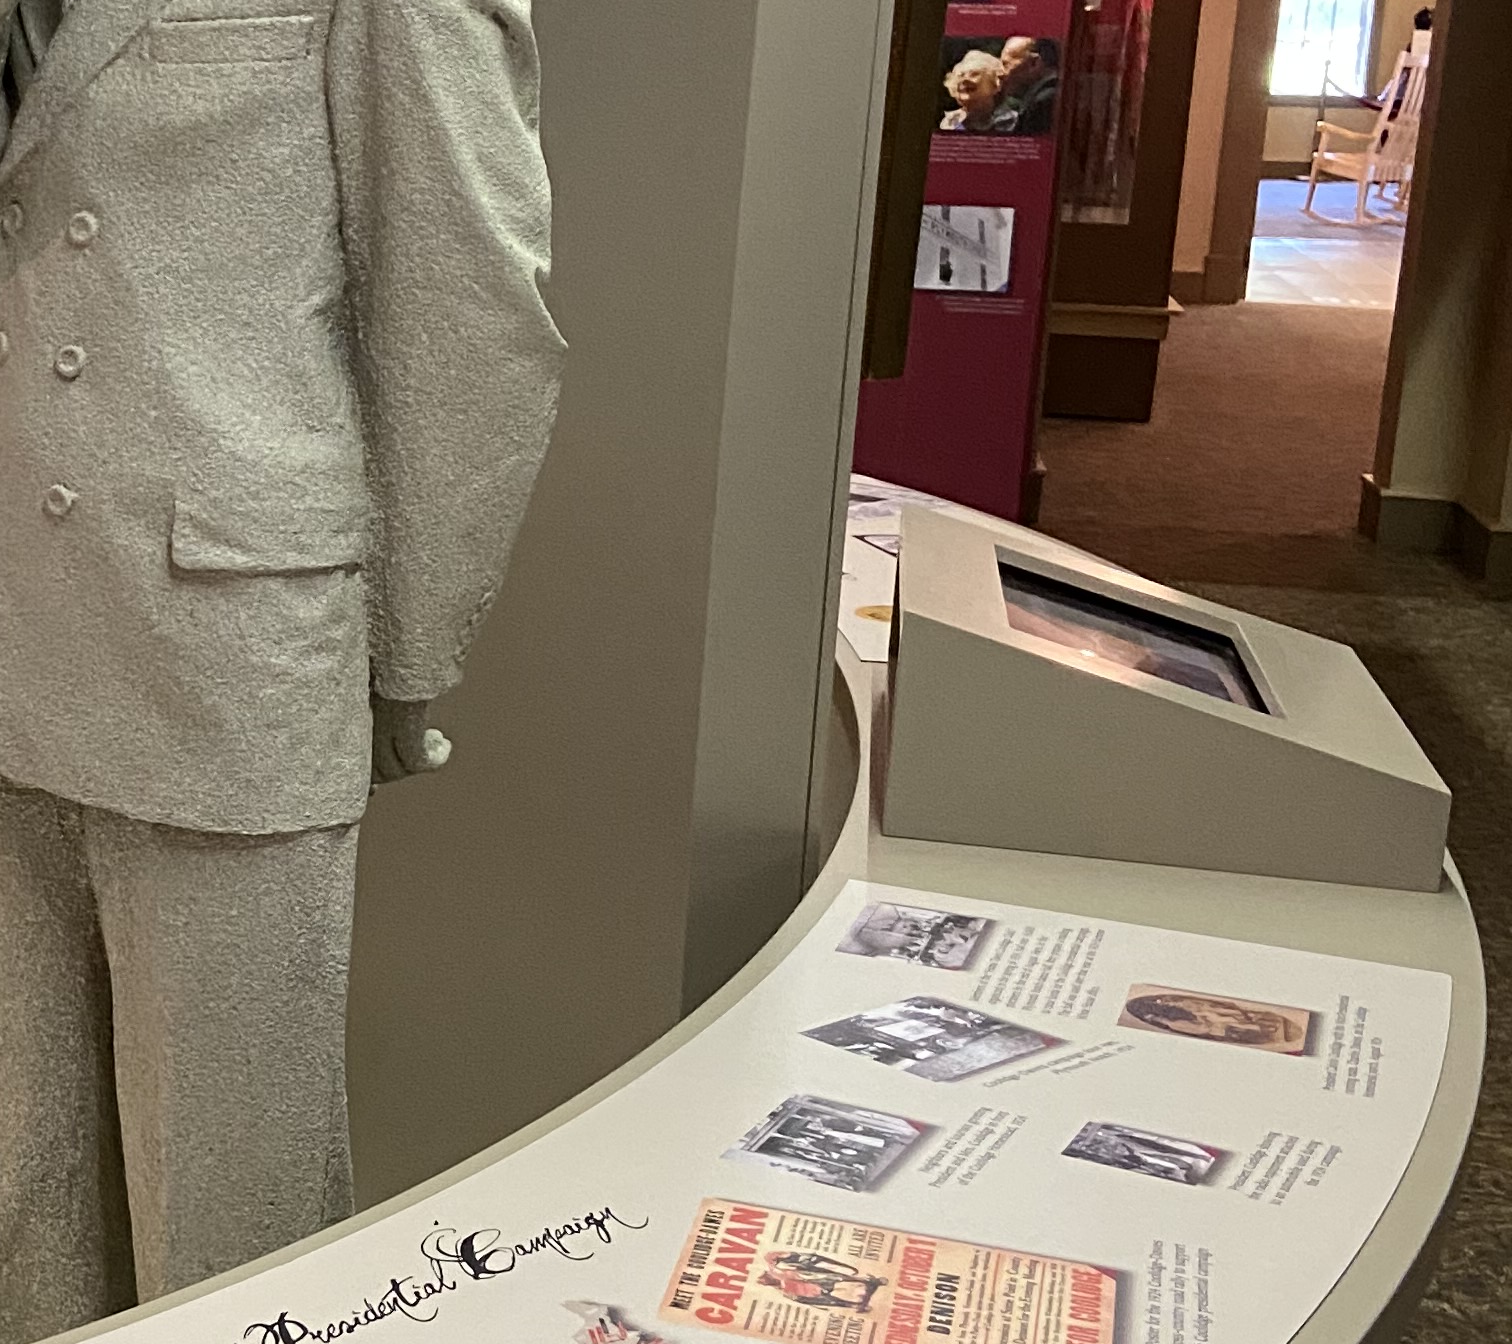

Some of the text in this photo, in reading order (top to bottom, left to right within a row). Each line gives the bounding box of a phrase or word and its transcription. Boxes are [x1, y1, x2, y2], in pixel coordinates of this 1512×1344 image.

[420, 1207, 648, 1280] Campaign
[695, 1207, 769, 1325] CARAVAN
[864, 1230, 885, 1261] INVITED
[898, 1246, 936, 1292] OCTOBER
[927, 1272, 960, 1335] DENISON
[1069, 1268, 1103, 1322] COOLIDGE
